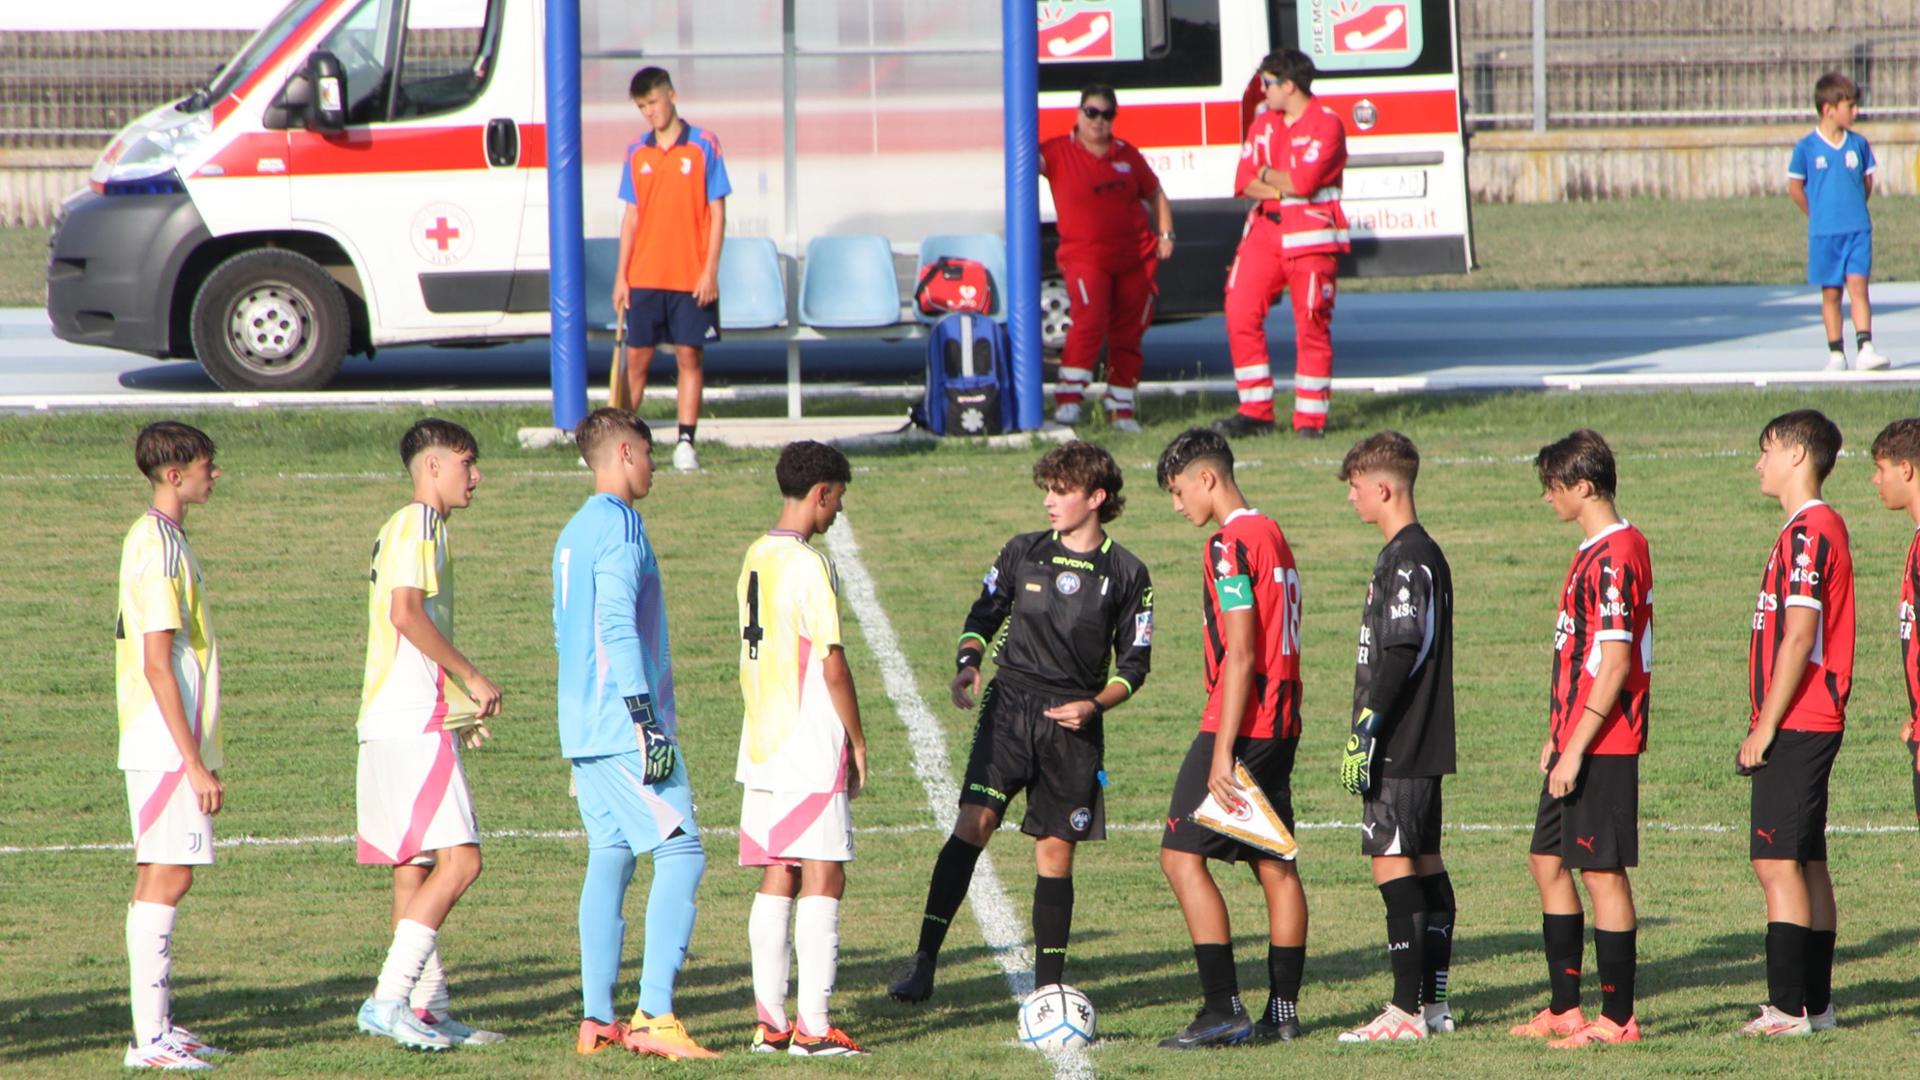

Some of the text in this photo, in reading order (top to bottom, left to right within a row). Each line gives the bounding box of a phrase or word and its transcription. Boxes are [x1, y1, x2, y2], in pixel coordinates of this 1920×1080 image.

[560, 547, 571, 611] 1
[1788, 568, 1820, 586] MSC
[743, 570, 764, 660] 4
[1273, 567, 1302, 656] 18
[1390, 603, 1418, 619] MSC
[1599, 602, 1630, 617] MSC
